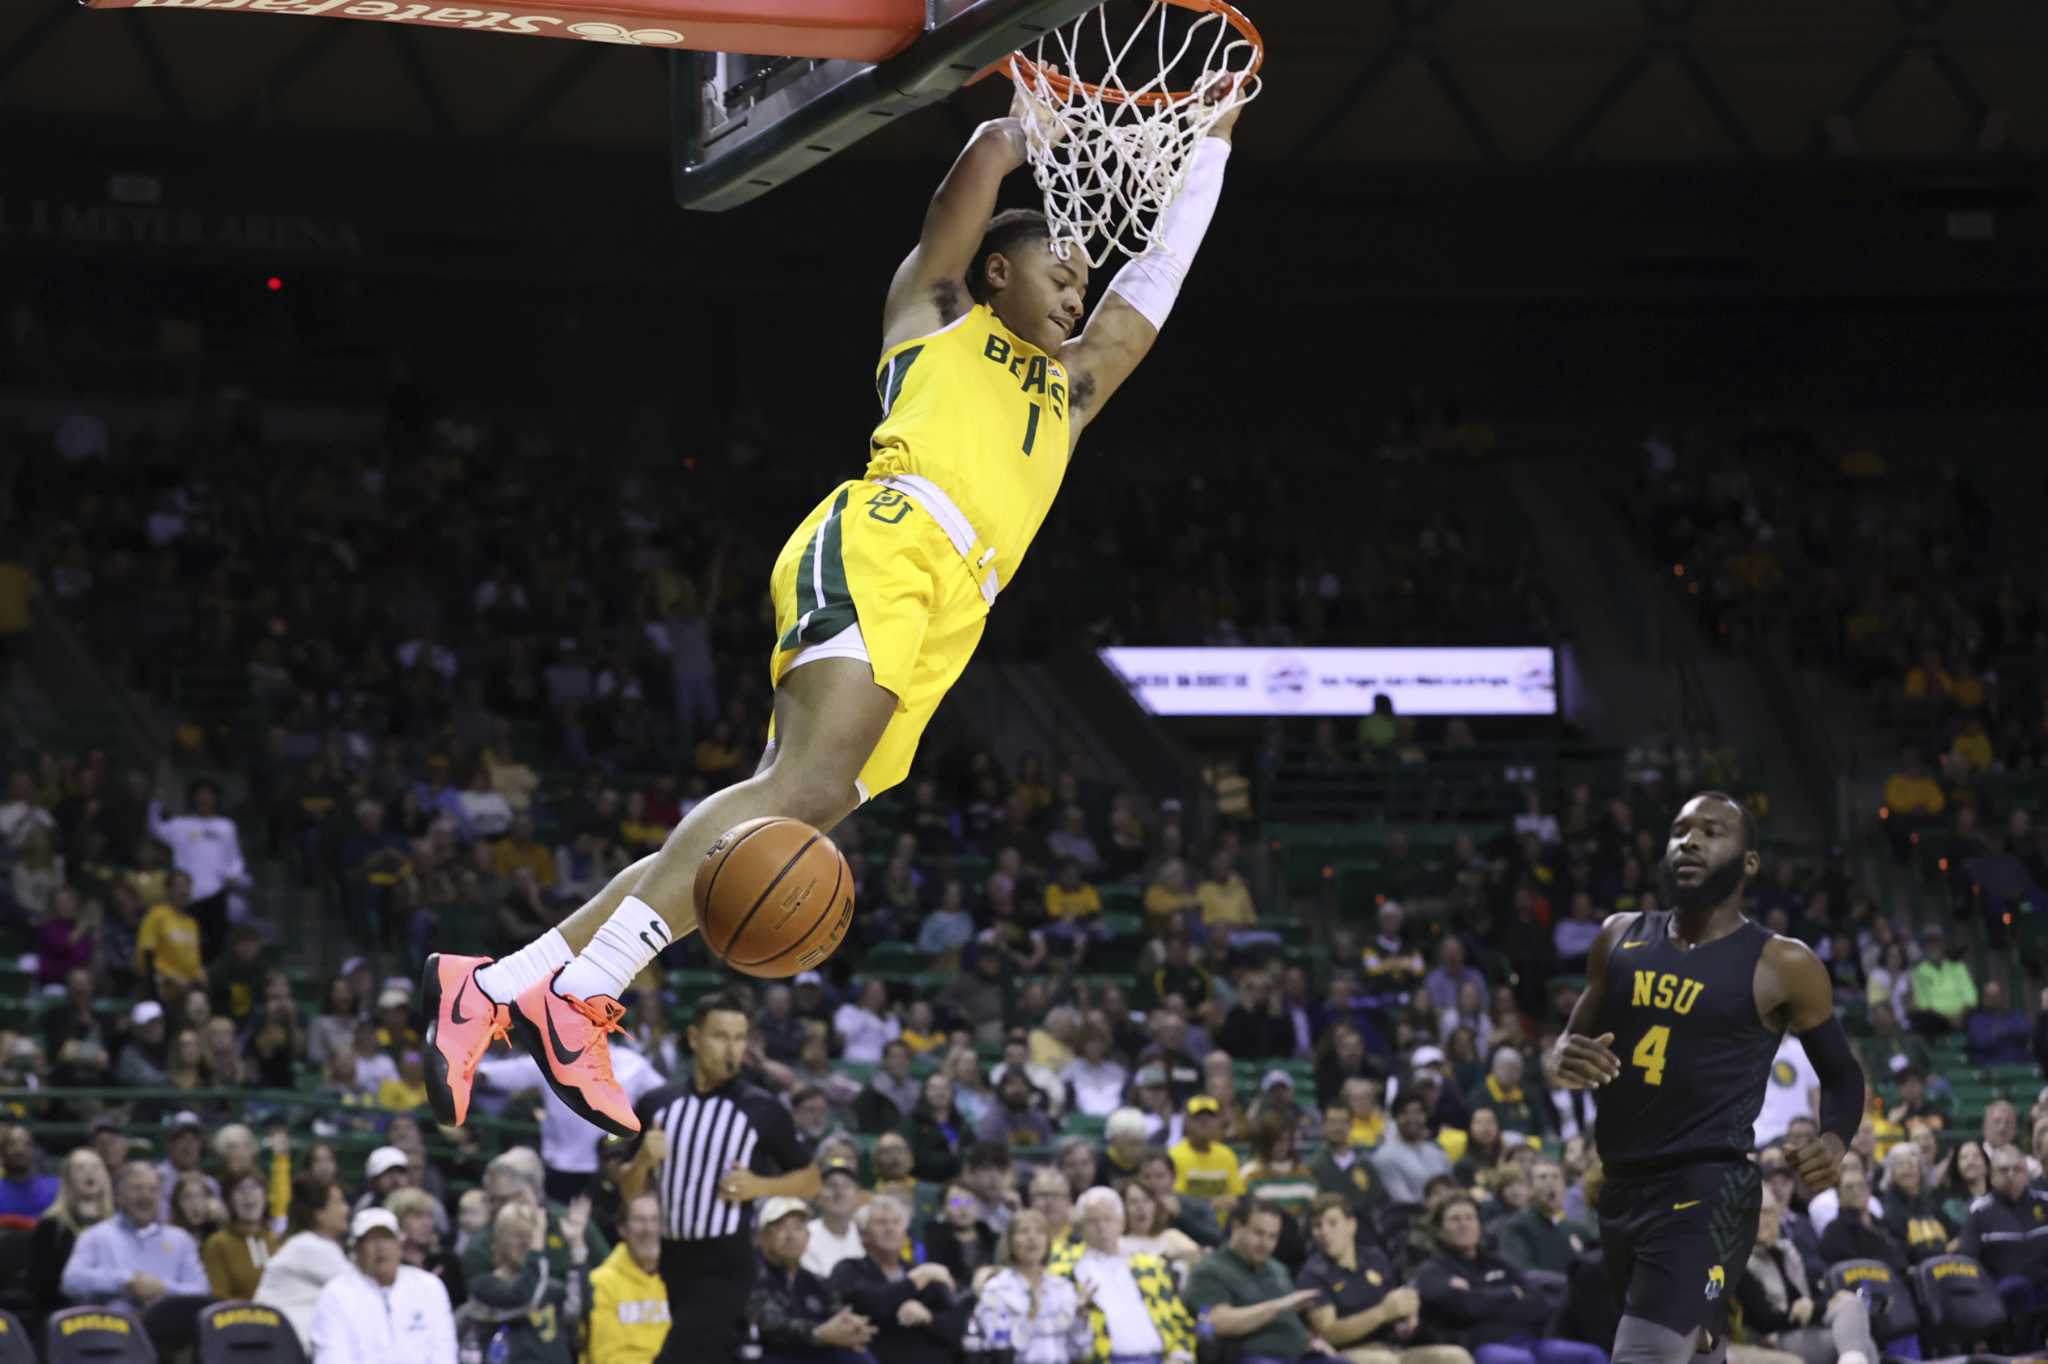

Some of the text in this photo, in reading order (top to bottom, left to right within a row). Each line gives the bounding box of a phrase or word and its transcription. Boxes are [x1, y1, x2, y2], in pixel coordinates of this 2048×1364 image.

[1022, 401, 1041, 457] 1
[1631, 969, 1705, 1016] NSU
[1632, 1023, 1671, 1086] 4
